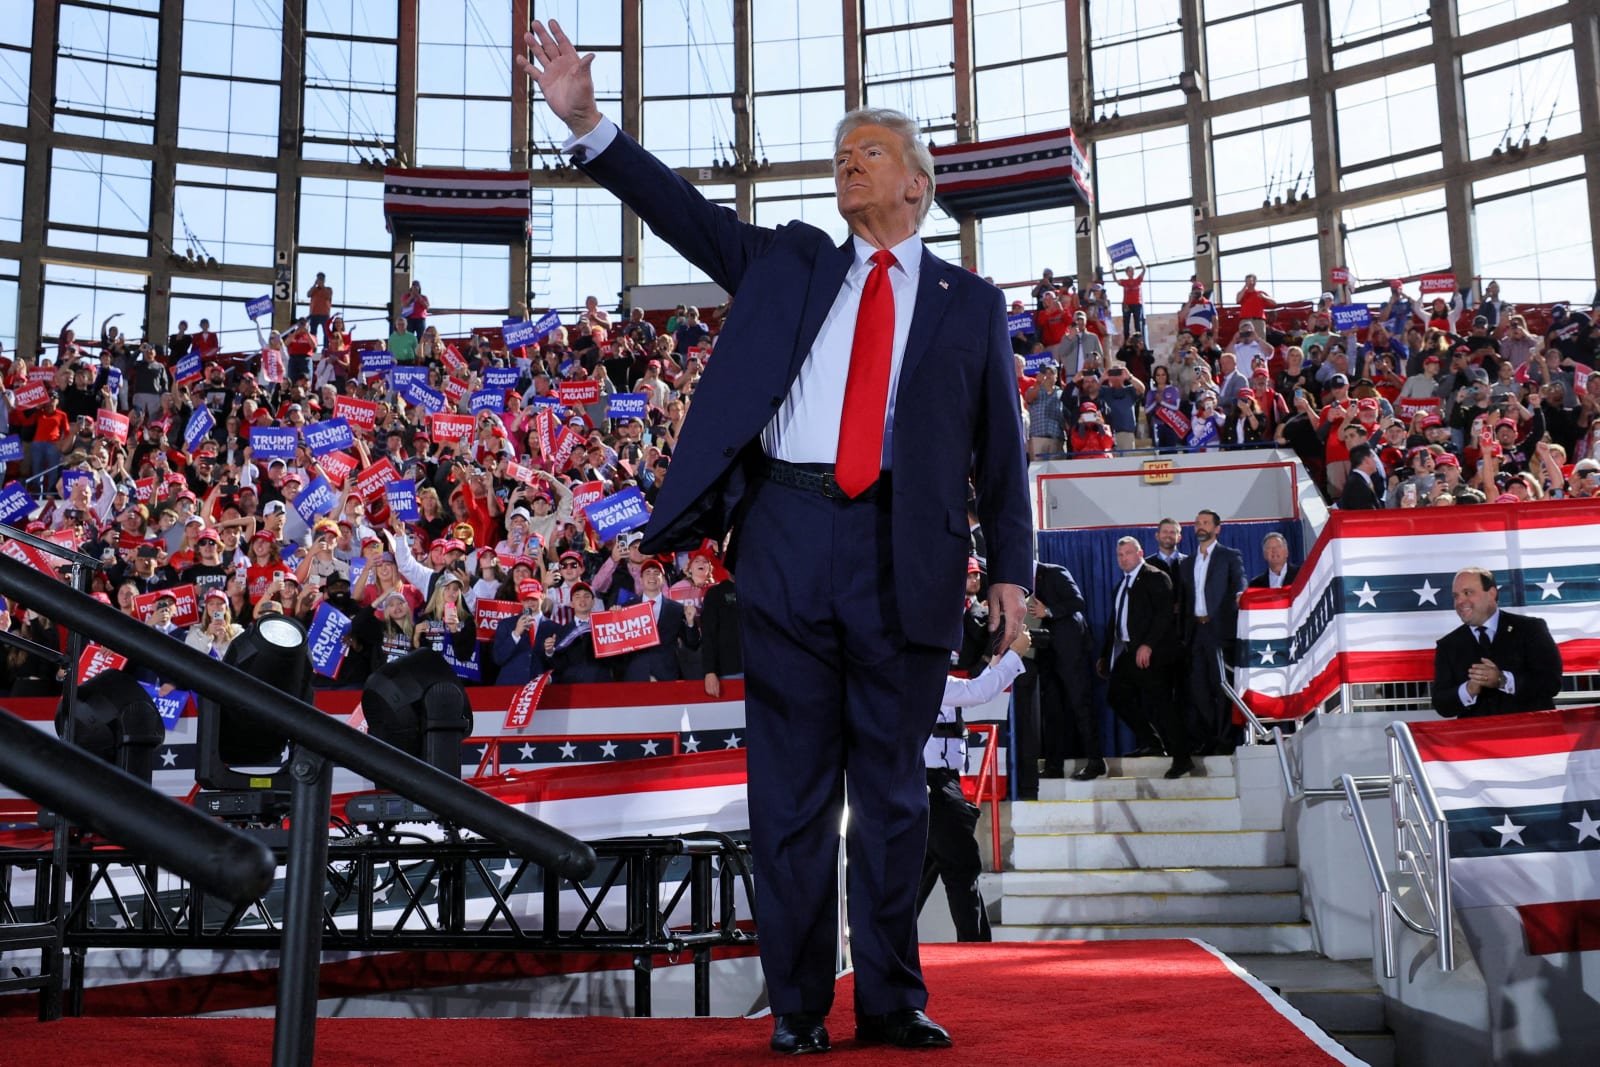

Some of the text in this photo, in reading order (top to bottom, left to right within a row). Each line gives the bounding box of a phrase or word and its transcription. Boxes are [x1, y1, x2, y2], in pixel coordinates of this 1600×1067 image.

[1076, 217, 1090, 235] 4
[1196, 234, 1209, 254] 5
[396, 254, 409, 272] 4
[276, 282, 290, 300] 3
[1335, 309, 1367, 320] TRUMP
[506, 327, 533, 341] TRUMP
[411, 383, 441, 407] TRUMP
[472, 395, 502, 406] TRUMP
[563, 392, 594, 400] AGAIN!
[338, 404, 375, 417] TRUMP
[100, 417, 128, 430] TRUMP
[355, 415, 366, 423] FIX
[435, 421, 472, 432] TRUMP
[187, 415, 208, 443] AGAIN!
[308, 425, 348, 442] TRUMP
[0, 442, 19, 450] UMP
[253, 435, 295, 445] TRUMP
[310, 433, 351, 449] WILL FIX IT
[359, 467, 392, 490] DREAM BIG,
[1149, 463, 1169, 479] EXIT
[363, 473, 394, 498] AGAIN!
[298, 485, 327, 515] TRUMP
[323, 494, 331, 502] IT
[400, 491, 414, 500] BIG,
[0, 498, 28, 519] GAIN!
[592, 496, 641, 521] DREAM BIG,
[598, 505, 642, 531] AGAIN!
[196, 575, 227, 584] FIGHT
[176, 595, 193, 606] BIG,
[479, 610, 511, 619] DREAM
[595, 615, 650, 636] TRUMP
[312, 612, 339, 662] TRUMP
[318, 618, 346, 667] WILL FIX IT
[597, 626, 652, 645] WILL FIX IT
